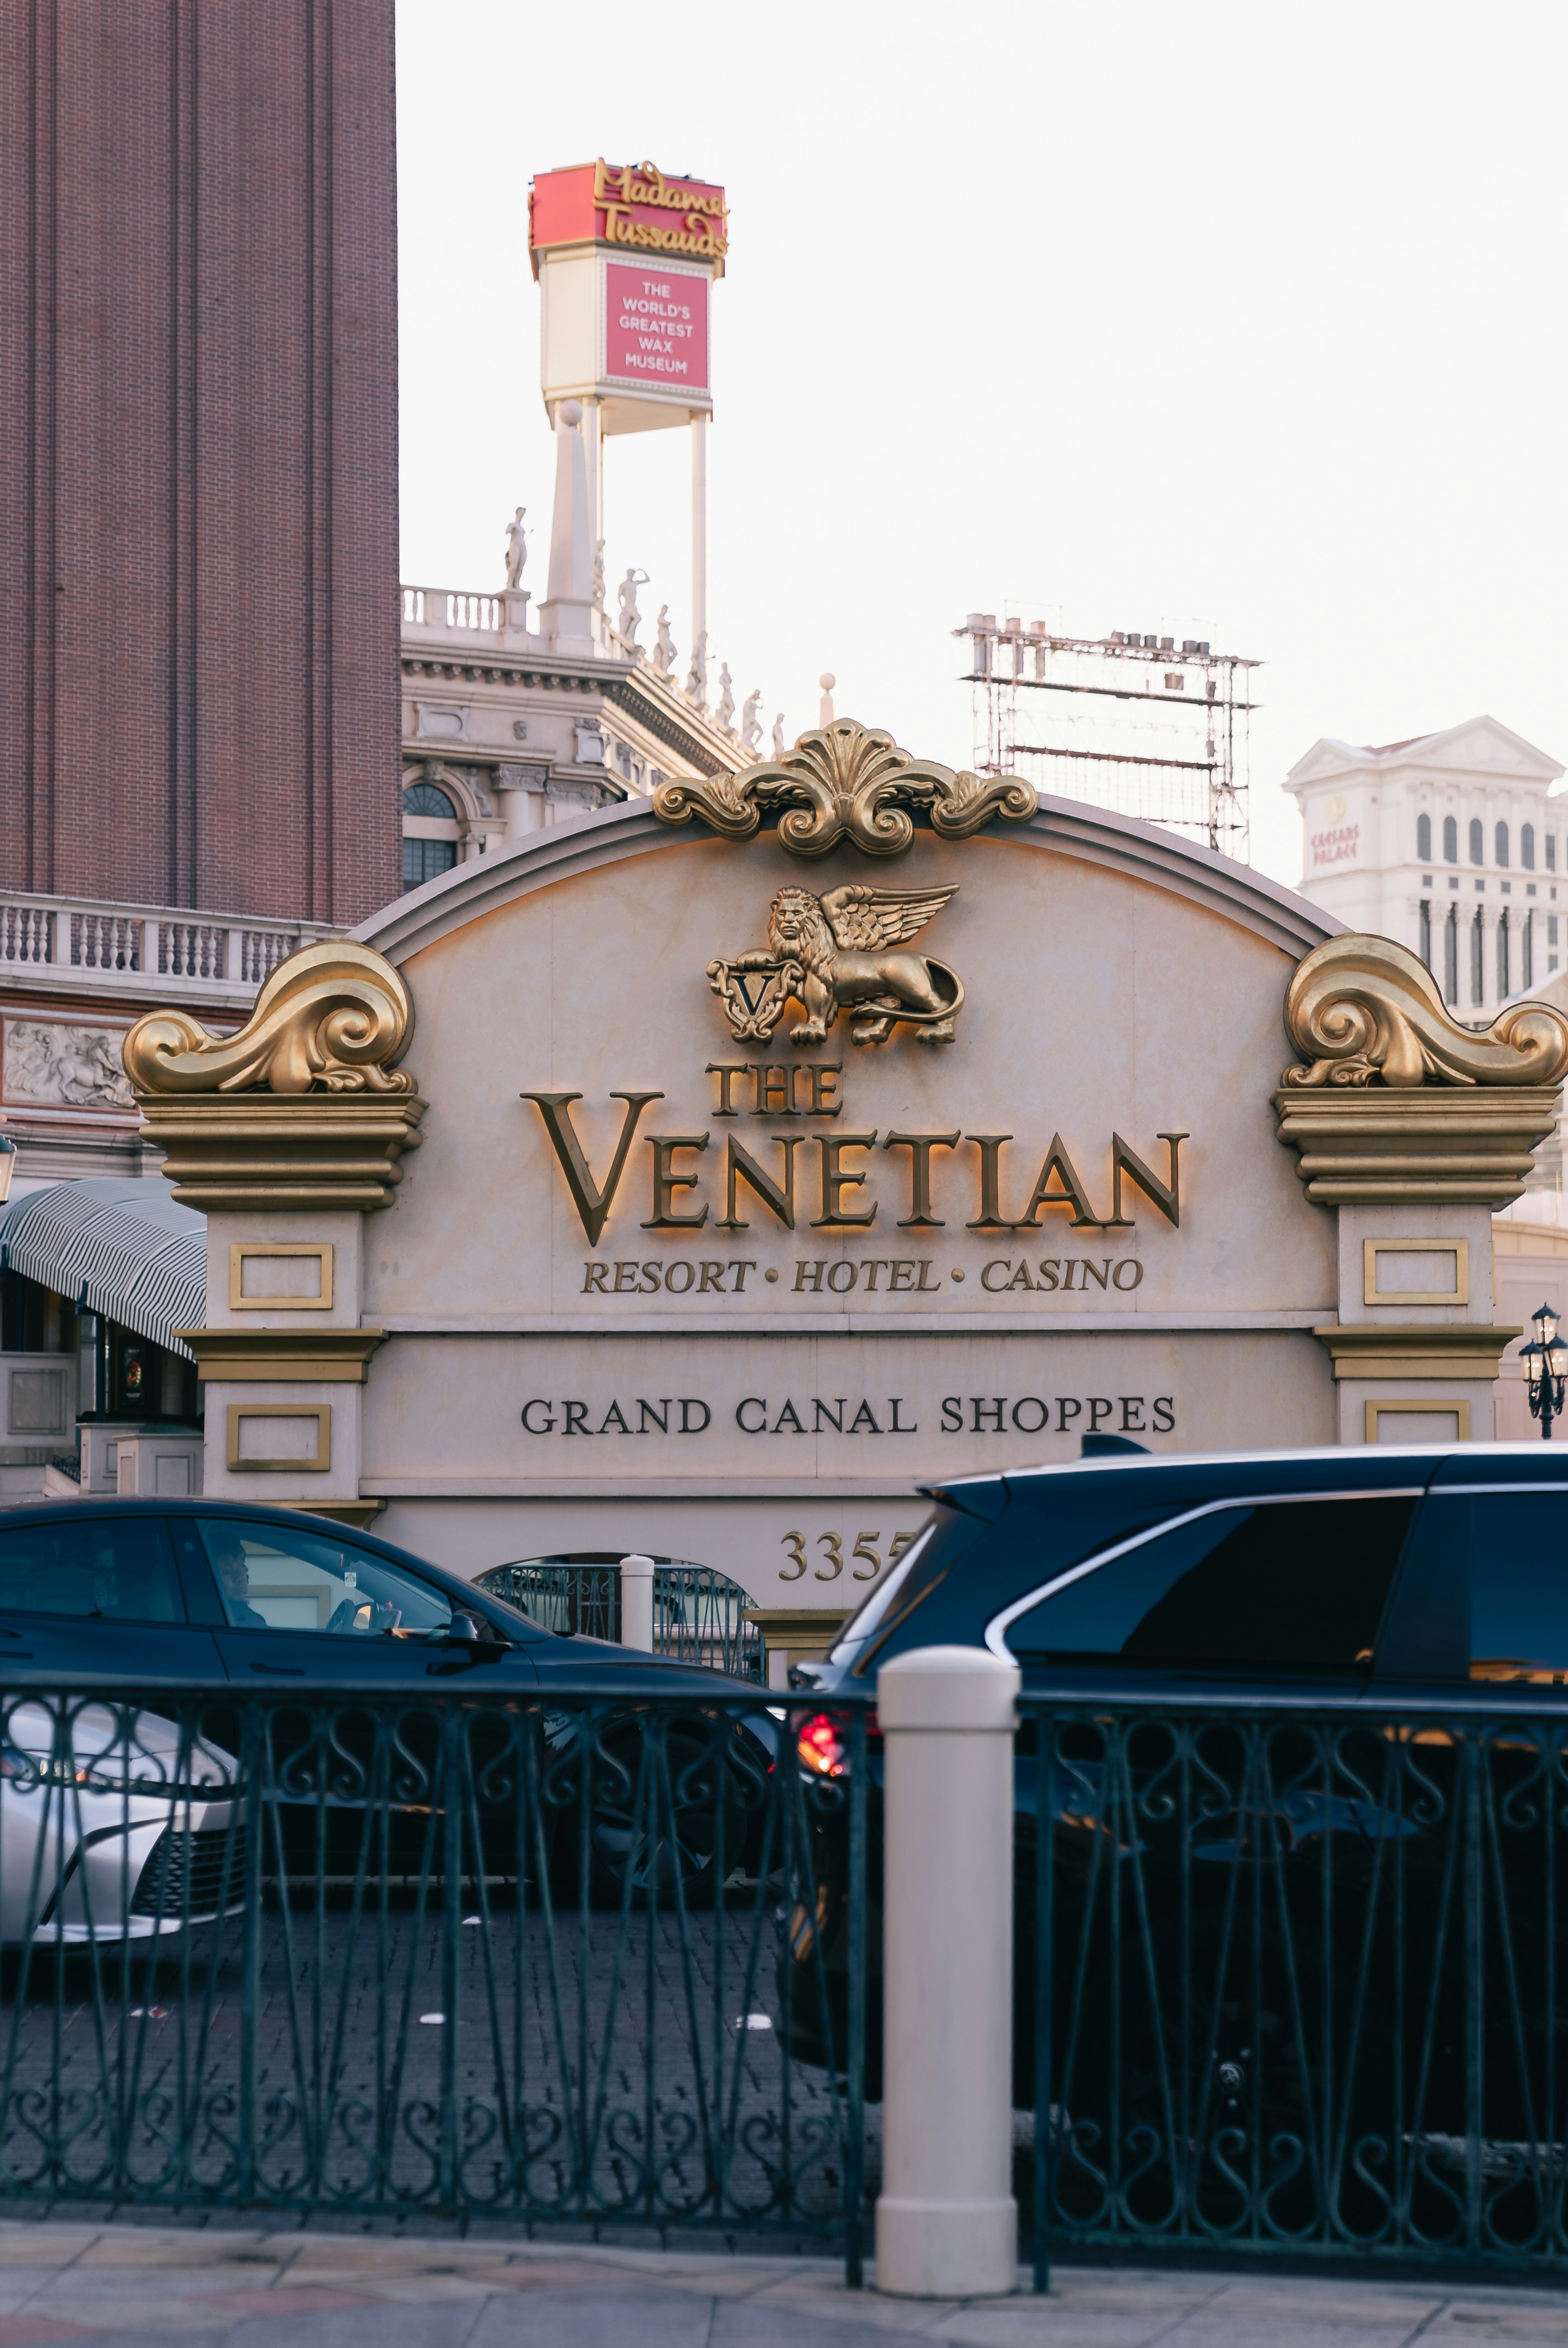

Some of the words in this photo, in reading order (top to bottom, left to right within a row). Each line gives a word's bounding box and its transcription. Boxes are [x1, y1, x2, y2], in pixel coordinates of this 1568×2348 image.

[594, 157, 730, 217] Madame
[592, 199, 730, 258] Tussauds
[642, 281, 671, 298] THE
[619, 315, 693, 338] GREATEST
[622, 297, 691, 320] WORLD'S
[625, 353, 688, 374] MUSEUM
[638, 336, 673, 354] WAX
[731, 975, 775, 1016] V
[705, 1062, 843, 1117] THE
[519, 1091, 1190, 1248] VENETIAN
[580, 1260, 757, 1294] RESORT
[791, 1260, 941, 1293] HOTEL
[981, 1259, 1144, 1293] CASINO
[521, 1398, 711, 1435] GRAND
[735, 1397, 917, 1434] CANAL
[941, 1396, 1176, 1433] SHOPPES
